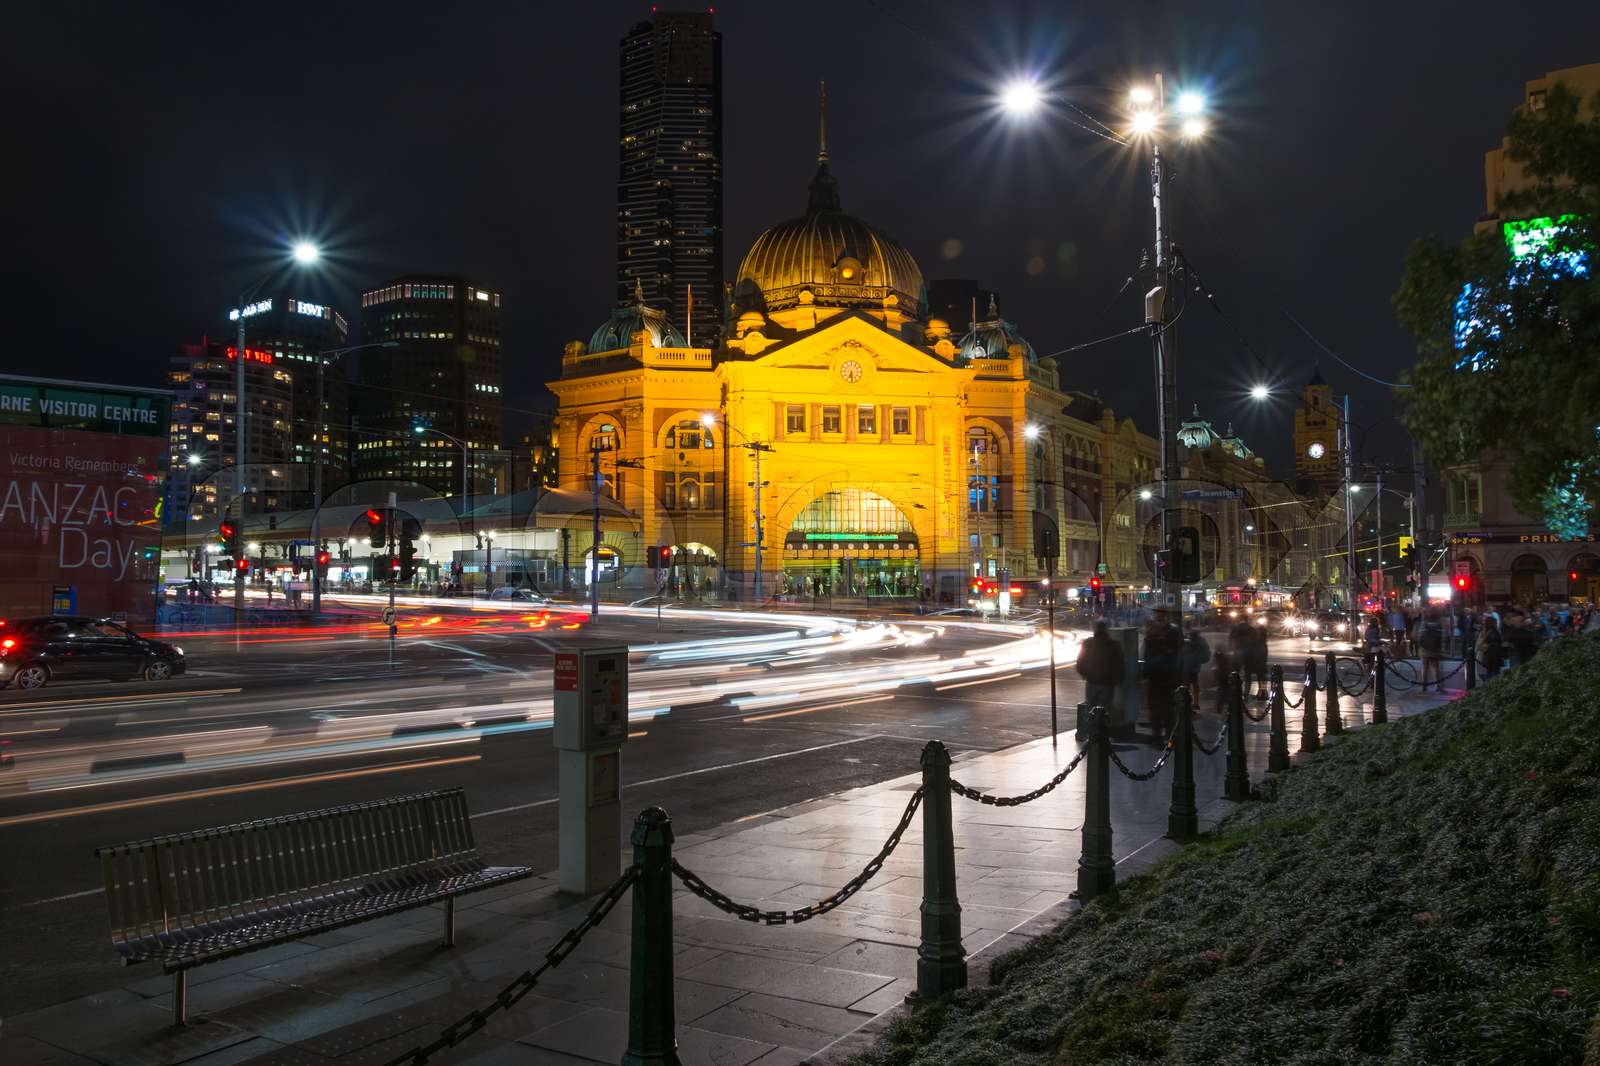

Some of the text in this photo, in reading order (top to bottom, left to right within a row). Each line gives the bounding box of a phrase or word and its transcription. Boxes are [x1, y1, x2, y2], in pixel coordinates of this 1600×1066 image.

[254, 350, 273, 364] WEST
[40, 399, 97, 419] VISITOR
[104, 405, 158, 424] CENTRE
[9, 451, 140, 473] Victoria Remembers
[0, 480, 137, 526] ANZAC
[58, 527, 135, 582] Day
